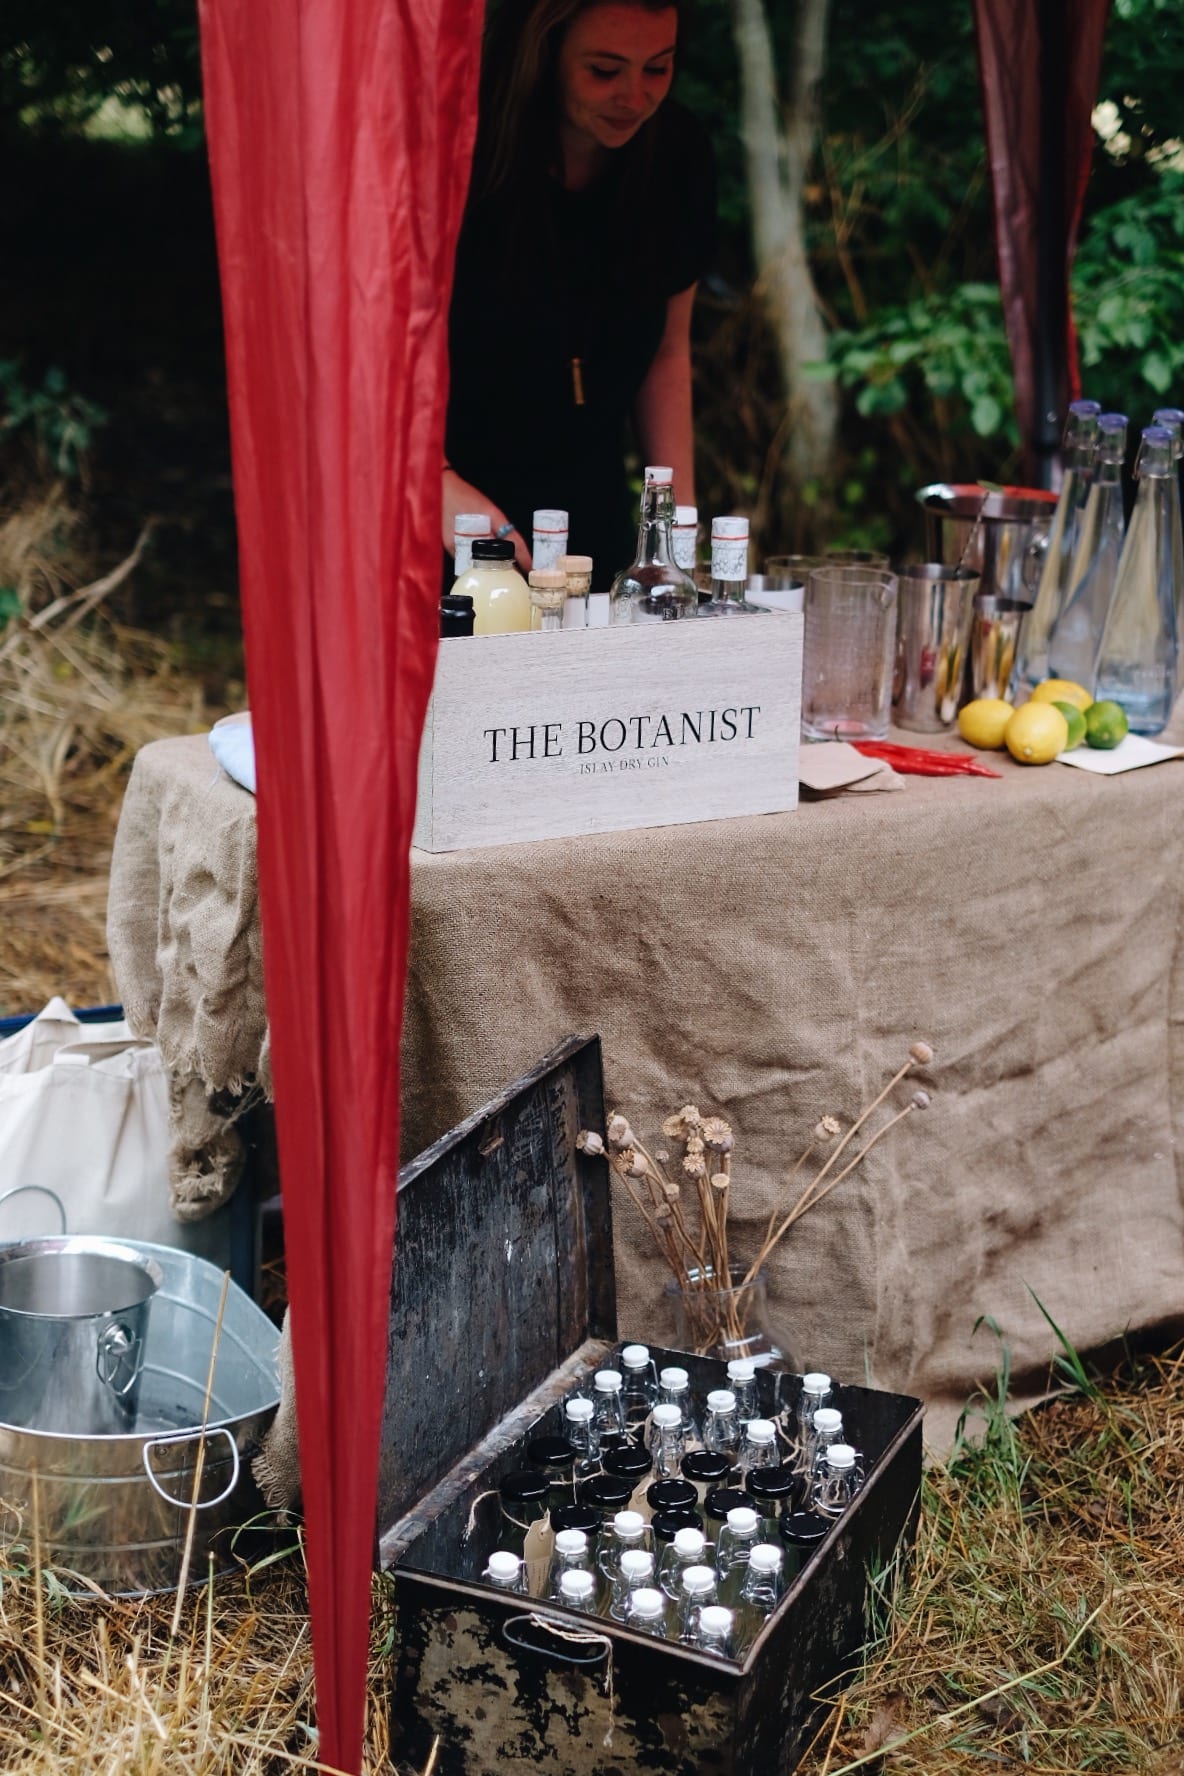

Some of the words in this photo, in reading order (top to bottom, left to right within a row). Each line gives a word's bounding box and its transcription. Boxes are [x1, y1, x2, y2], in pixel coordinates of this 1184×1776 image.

[483, 723, 563, 763] THE
[576, 706, 761, 755] BOTANIST
[580, 760, 616, 775] ISLAY
[620, 758, 642, 771] DRY
[647, 756, 669, 768] GIN
